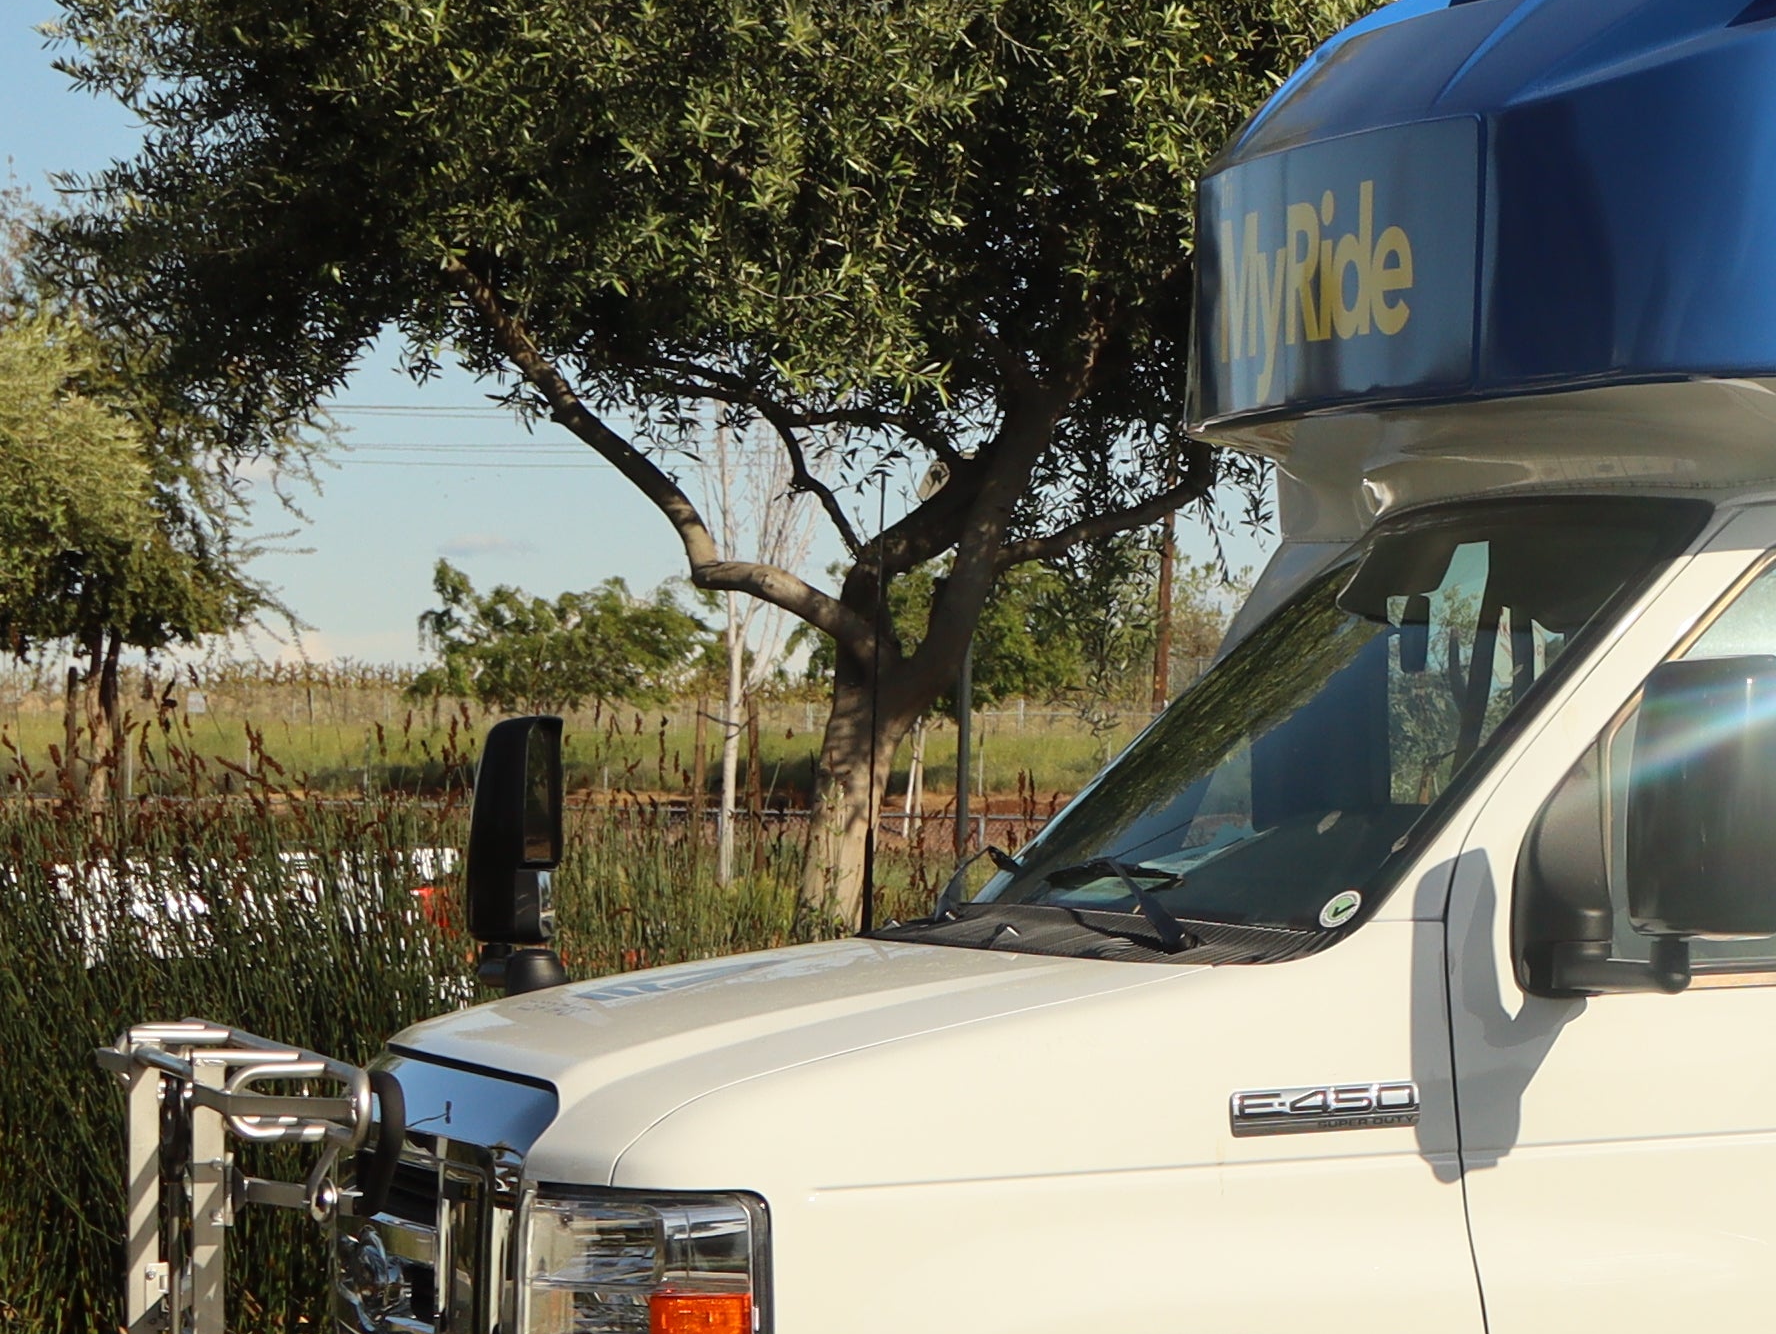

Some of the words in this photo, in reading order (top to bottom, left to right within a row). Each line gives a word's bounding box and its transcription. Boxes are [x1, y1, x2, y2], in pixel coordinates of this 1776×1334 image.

[1220, 179, 1414, 404] MyRide
[1236, 1083, 1416, 1120] E-450
[1316, 1117, 1370, 1130] SUPER
[1372, 1114, 1415, 1126] DUTY
